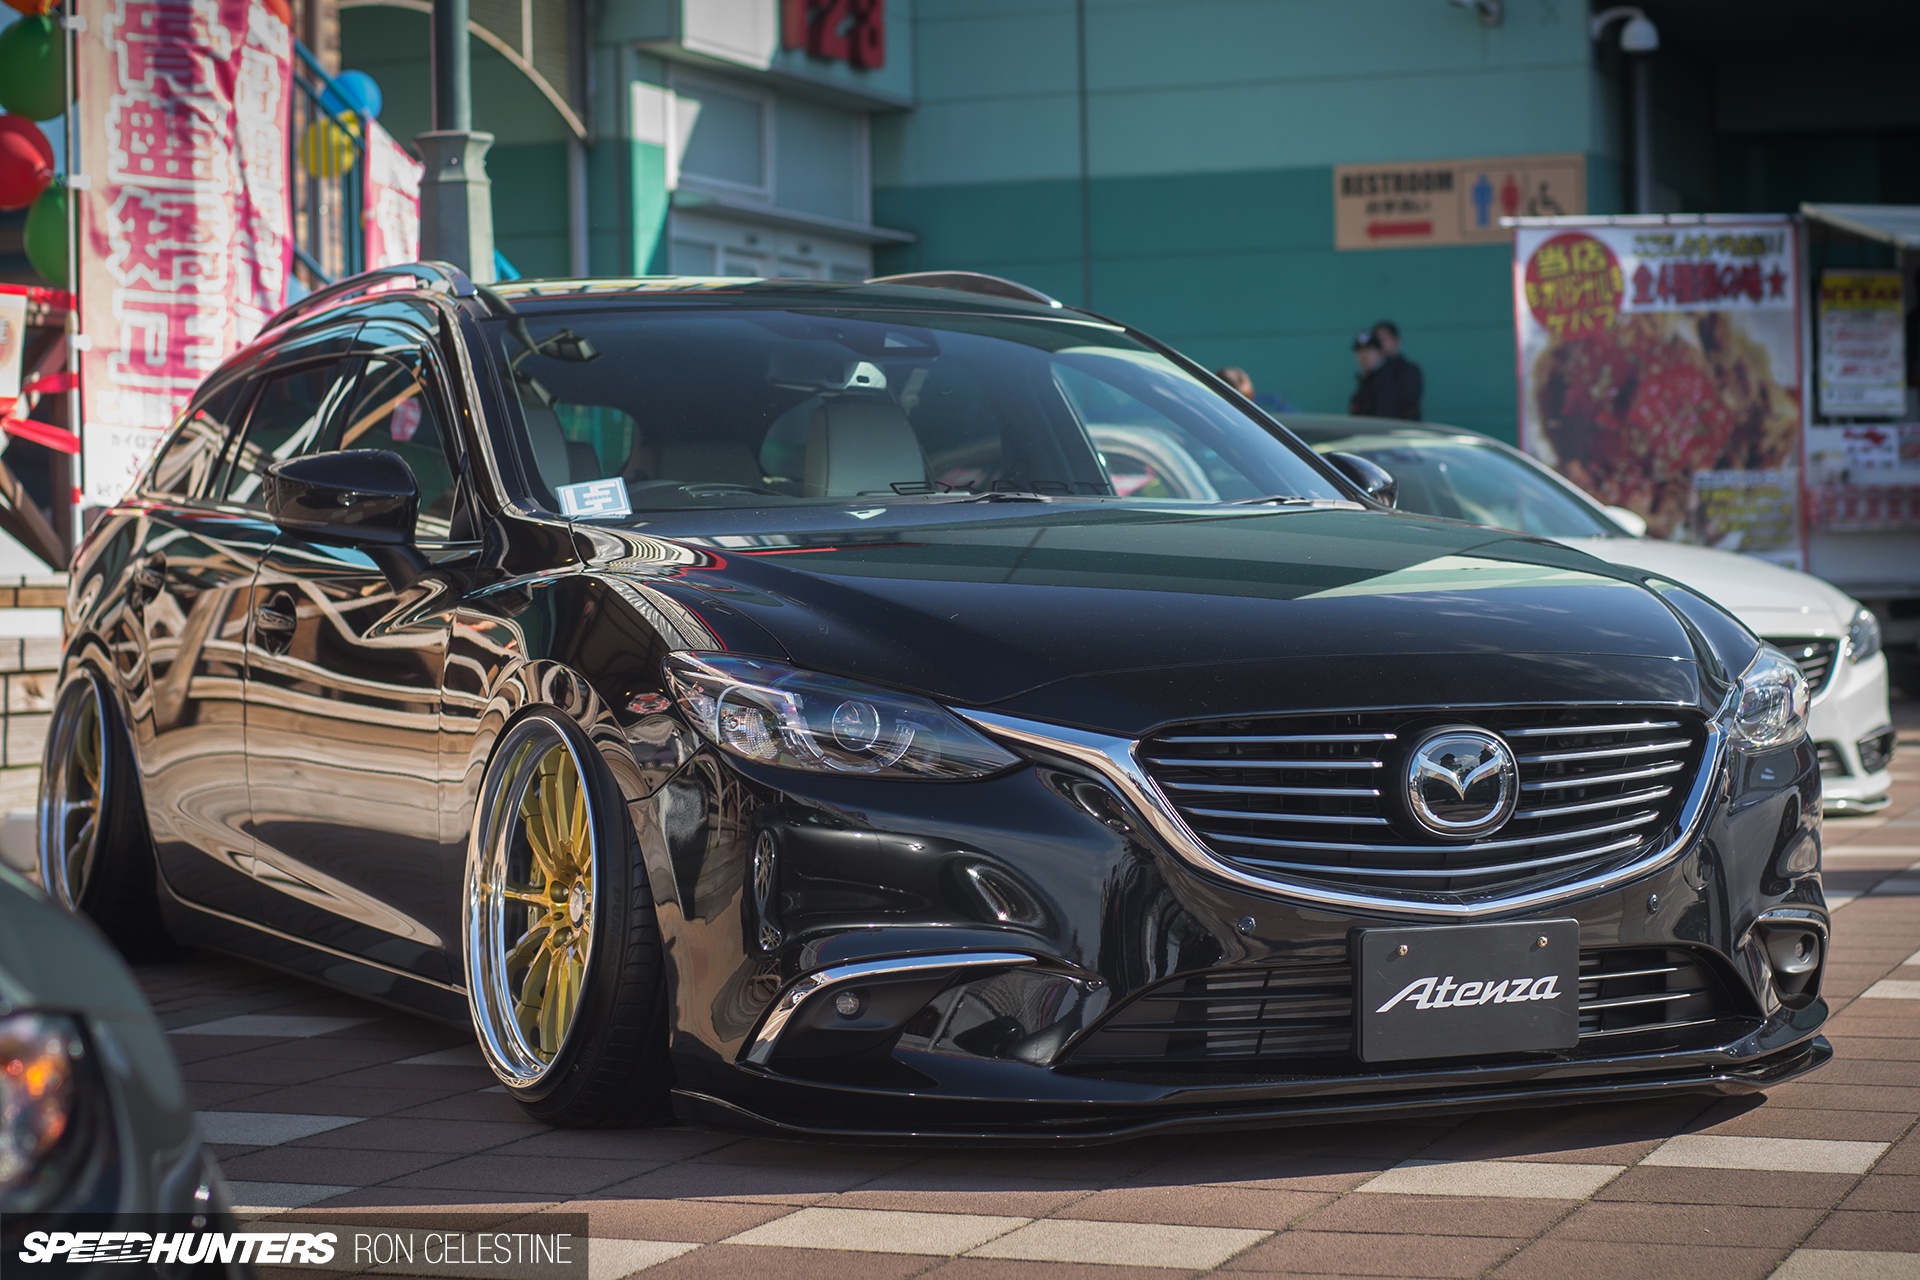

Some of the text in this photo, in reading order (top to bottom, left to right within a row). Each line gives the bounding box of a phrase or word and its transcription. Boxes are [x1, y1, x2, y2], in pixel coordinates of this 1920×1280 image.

[1342, 171, 1453, 196] RESTROOM
[1537, 239, 1608, 279] 当店
[1375, 974, 1562, 1013] Atenza
